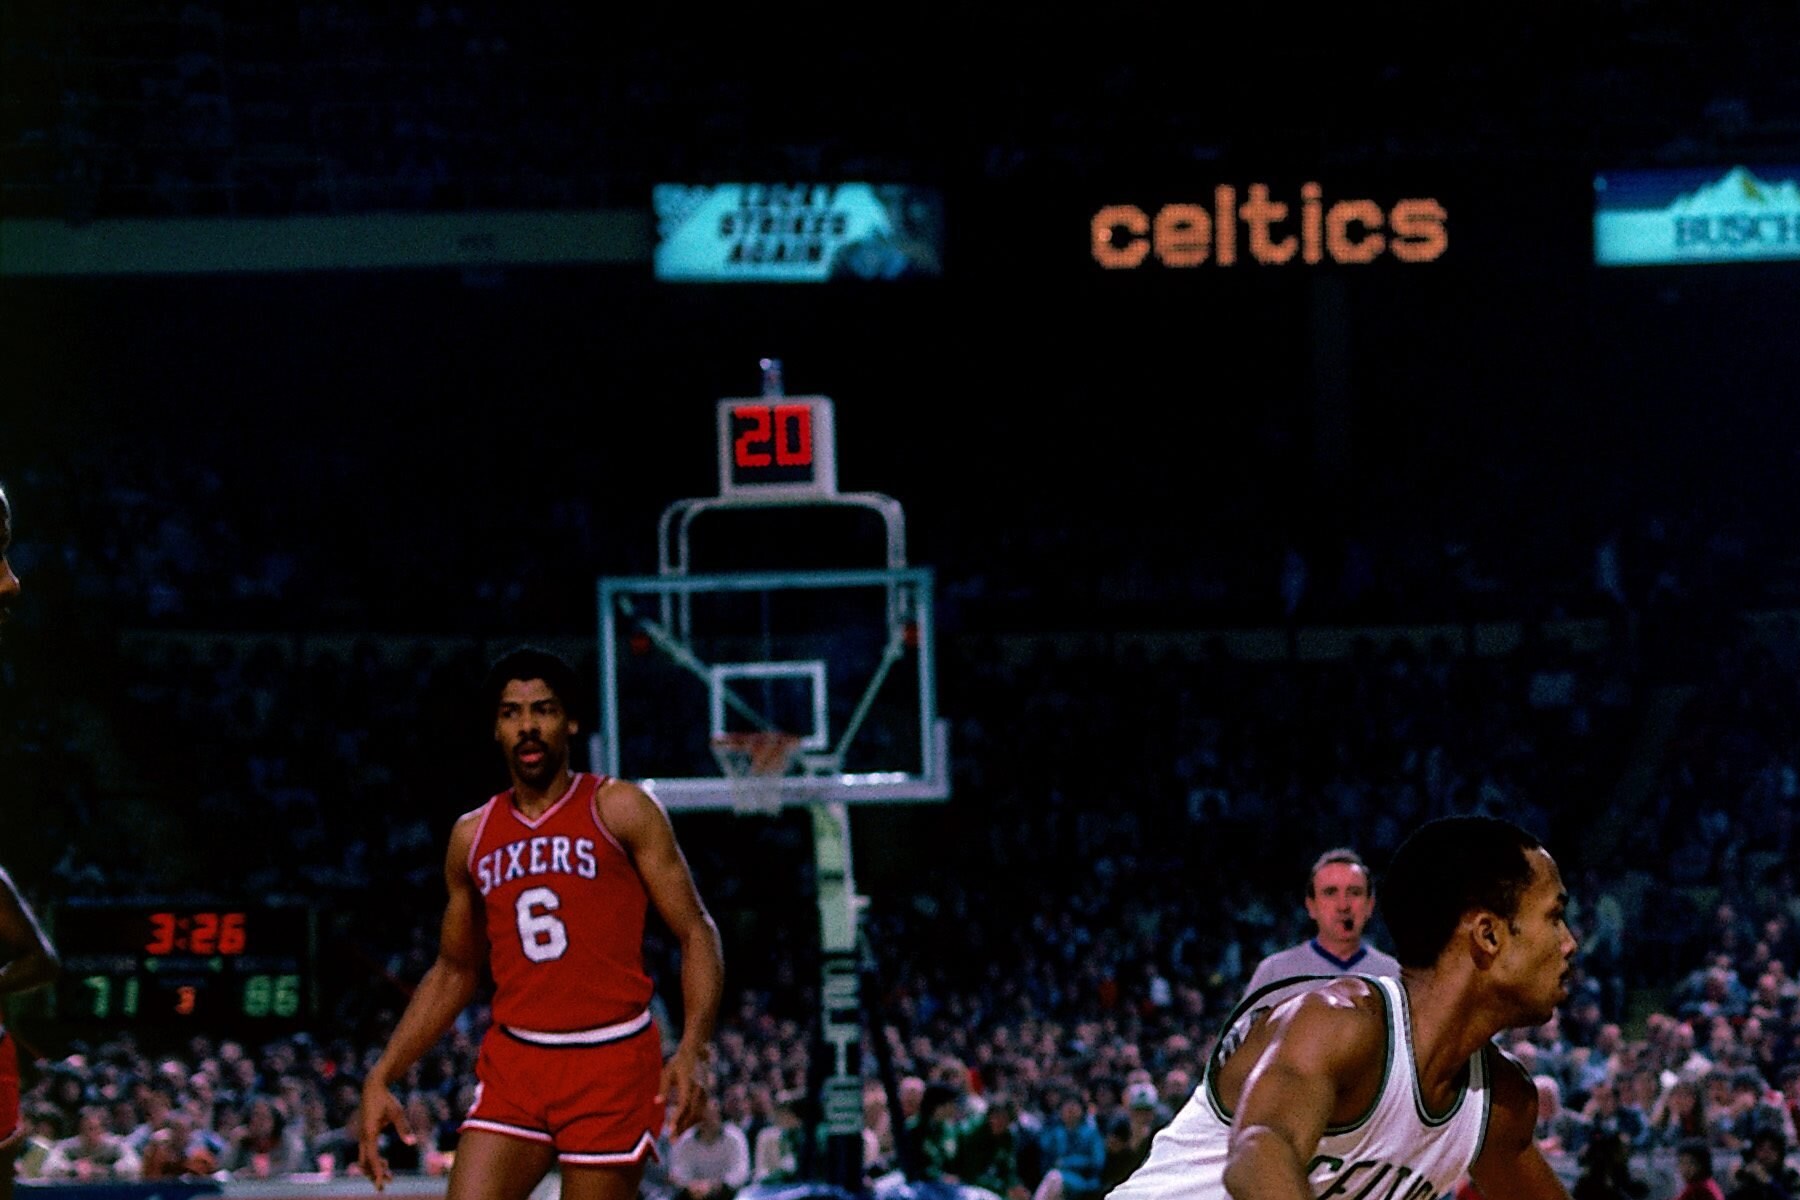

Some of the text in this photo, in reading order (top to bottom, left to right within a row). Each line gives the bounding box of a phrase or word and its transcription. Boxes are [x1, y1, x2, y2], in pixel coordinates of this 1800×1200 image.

[1090, 181, 1449, 269] celtics
[734, 404, 812, 467] 20
[477, 836, 597, 896] SIXERS
[145, 912, 247, 955] 3:26
[515, 886, 569, 963] 6
